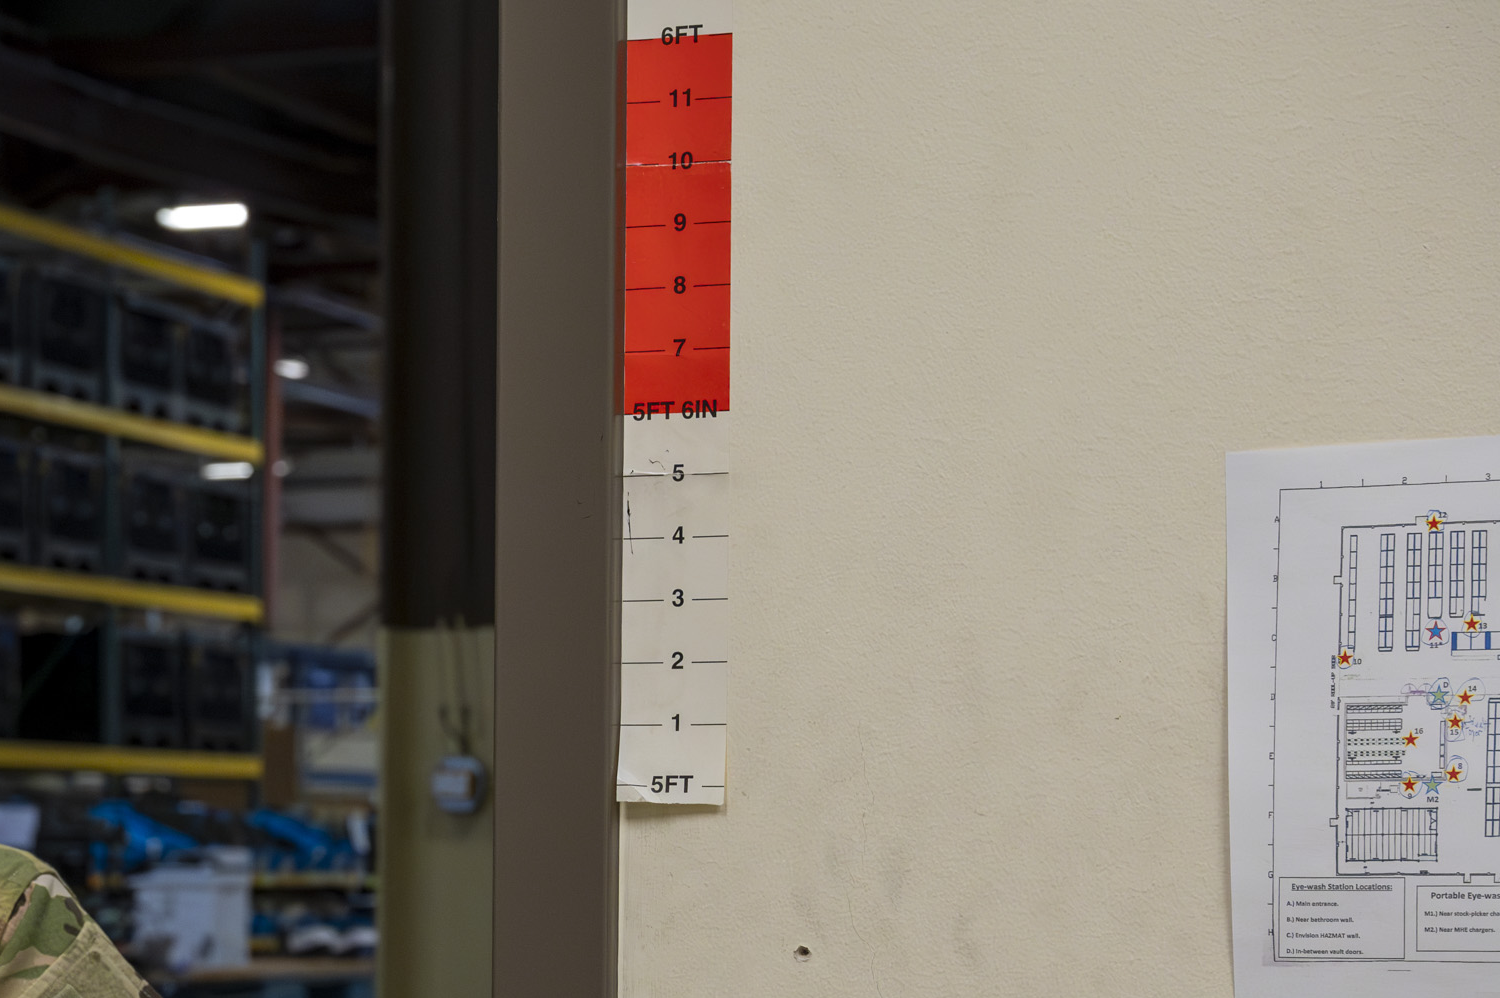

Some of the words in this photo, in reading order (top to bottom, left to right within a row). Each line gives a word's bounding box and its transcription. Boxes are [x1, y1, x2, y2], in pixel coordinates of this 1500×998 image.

[661, 24, 703, 45] 6FT
[669, 88, 692, 107] 11
[668, 151, 694, 170] 10
[673, 213, 687, 231] 9
[673, 276, 687, 294] 8
[673, 338, 687, 357] 7
[633, 401, 675, 421] 5FT
[682, 399, 718, 419] 6IN
[672, 464, 685, 482] 5
[672, 526, 685, 544] 4
[672, 589, 684, 607] 3
[671, 652, 684, 669] 2
[671, 714, 680, 732] 1
[650, 775, 694, 794] 5FT
